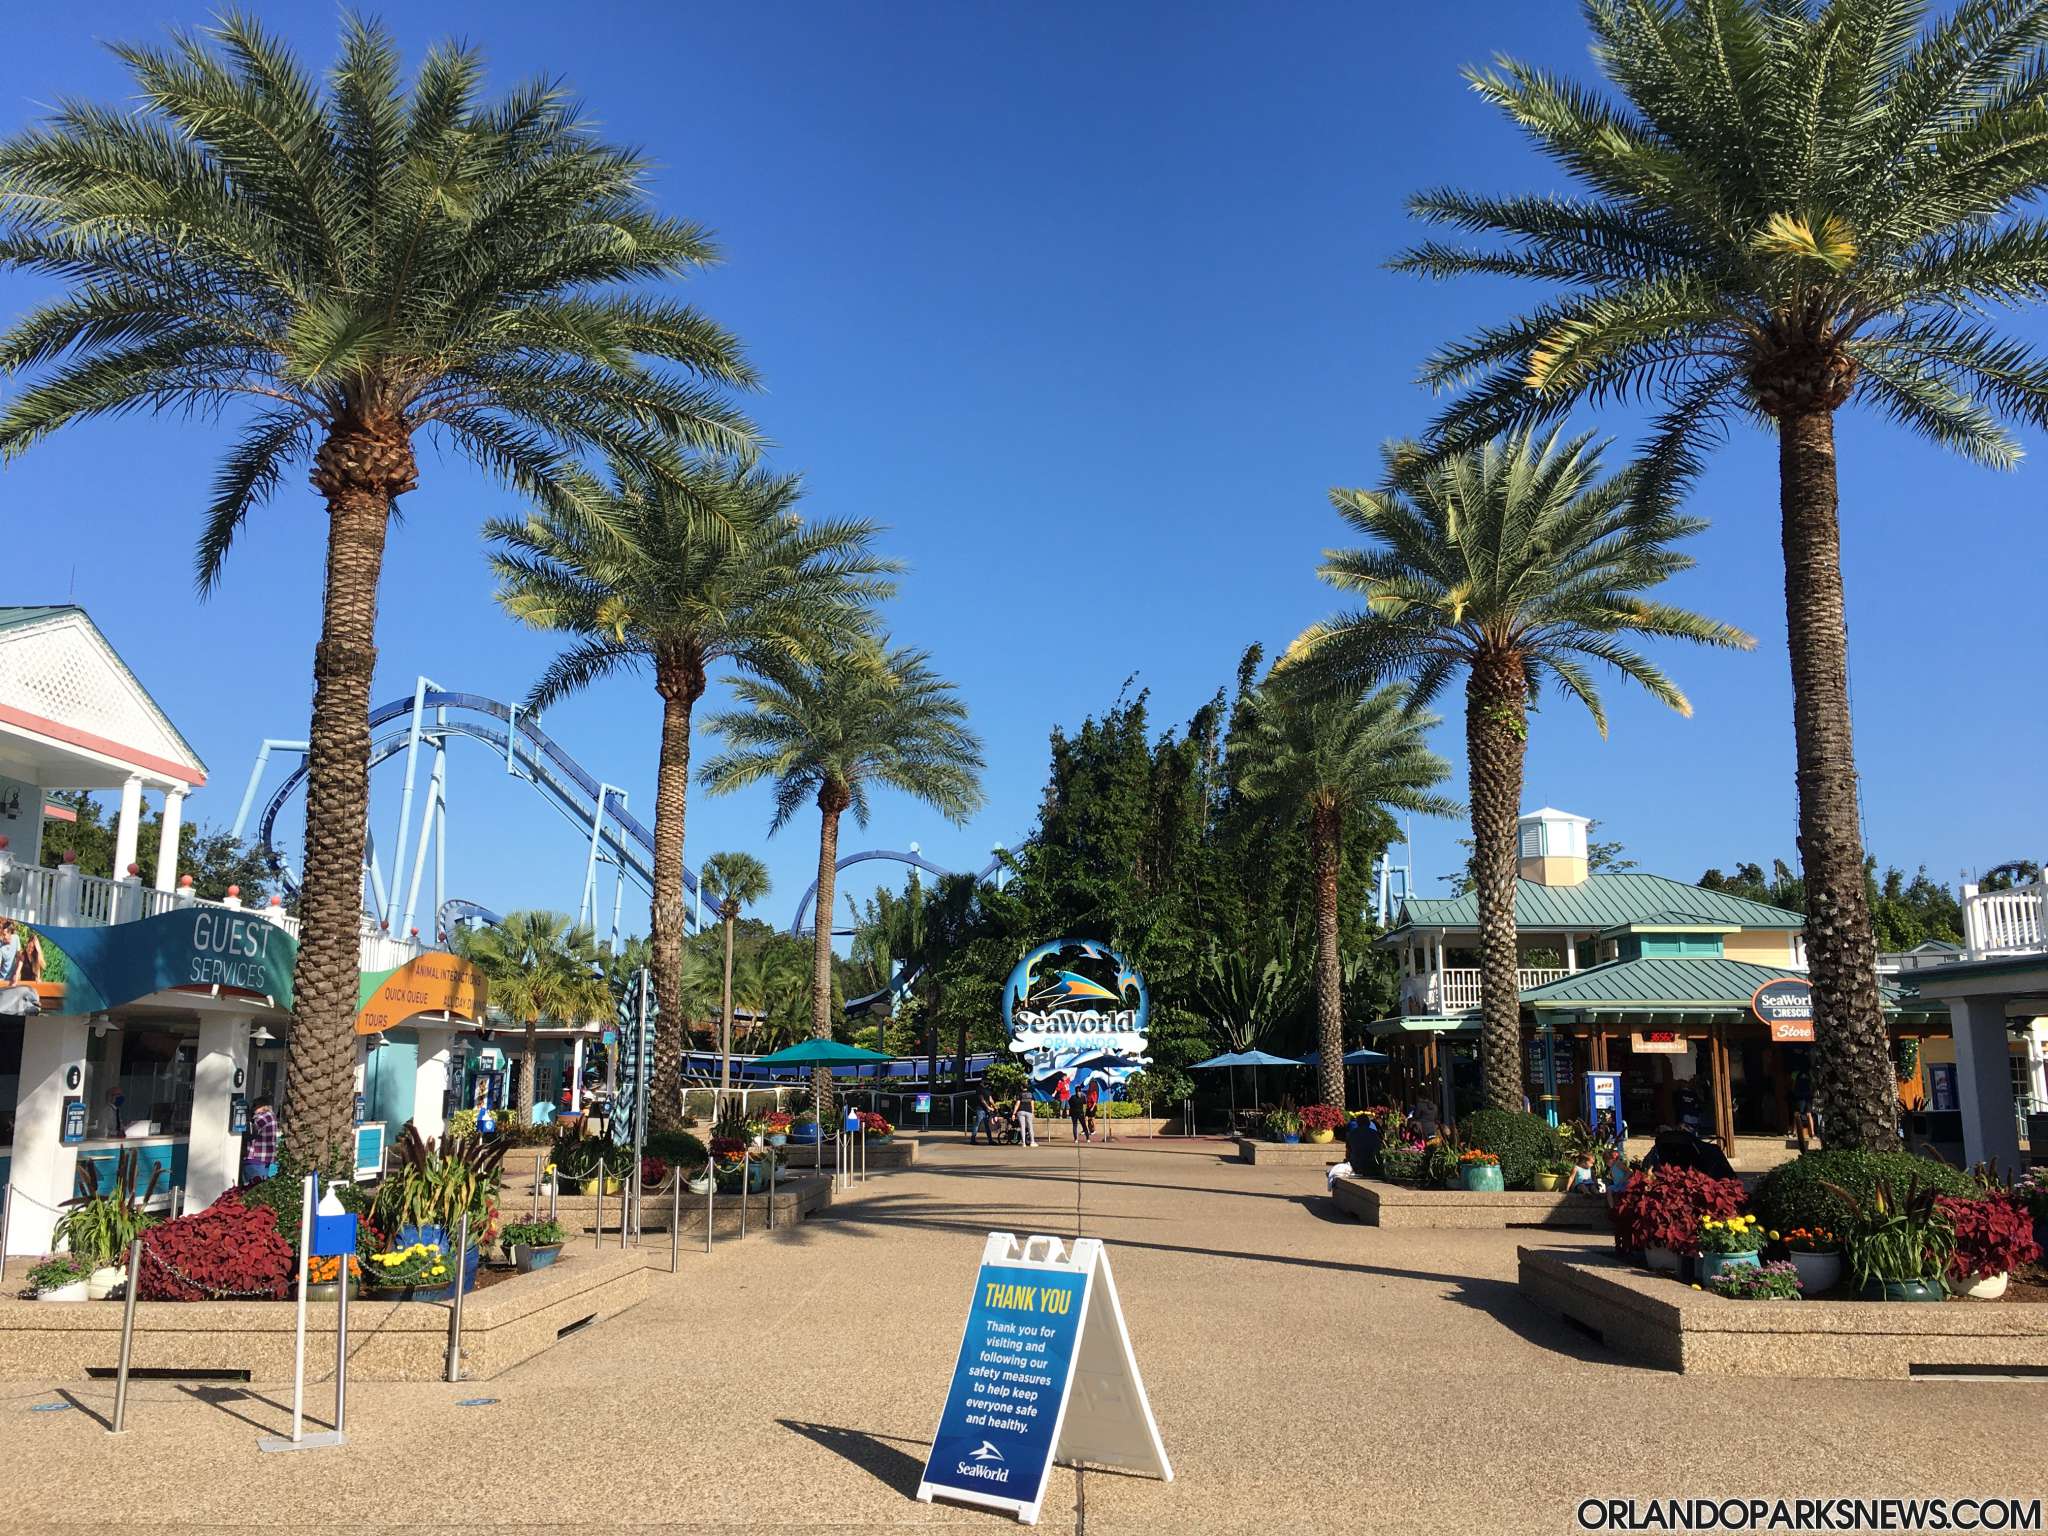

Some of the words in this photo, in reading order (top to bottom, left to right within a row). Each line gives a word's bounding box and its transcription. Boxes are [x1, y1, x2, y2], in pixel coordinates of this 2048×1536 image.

[193, 912, 274, 959] GUEST
[190, 956, 266, 988] SERVICES
[415, 963, 439, 980] ANIMAL
[384, 986, 406, 1001] QUICK
[406, 989, 429, 1005] QUEUE
[455, 997, 466, 1010] DAY
[1761, 994, 1813, 1006] SeaWorl
[364, 1013, 388, 1028] TOURS
[1014, 1009, 1136, 1035] SeaWorld
[1780, 1008, 1812, 1018] RESCUE
[1776, 1024, 1812, 1038] Store
[1043, 1037, 1118, 1049] ORLANDO
[984, 1282, 1037, 1311] THANK
[1039, 1287, 1072, 1315] YOU
[986, 1319, 1016, 1334] Thank
[1018, 1325, 1038, 1338] you
[1040, 1326, 1056, 1338] for
[986, 1336, 1023, 1352] visiting
[1025, 1340, 1046, 1353] and
[979, 1351, 1027, 1369] following
[1030, 1358, 1048, 1369] our
[968, 1365, 1001, 1381] safety
[1002, 1371, 1051, 1386] measures
[974, 1382, 985, 1393] to
[987, 1383, 1010, 1400] help
[1012, 1386, 1038, 1403] keep
[966, 1397, 1014, 1414] everyone
[1015, 1404, 1038, 1417] safe
[966, 1413, 986, 1426] and
[987, 1414, 1029, 1433] healthy.
[956, 1460, 1009, 1483] SeaWorld
